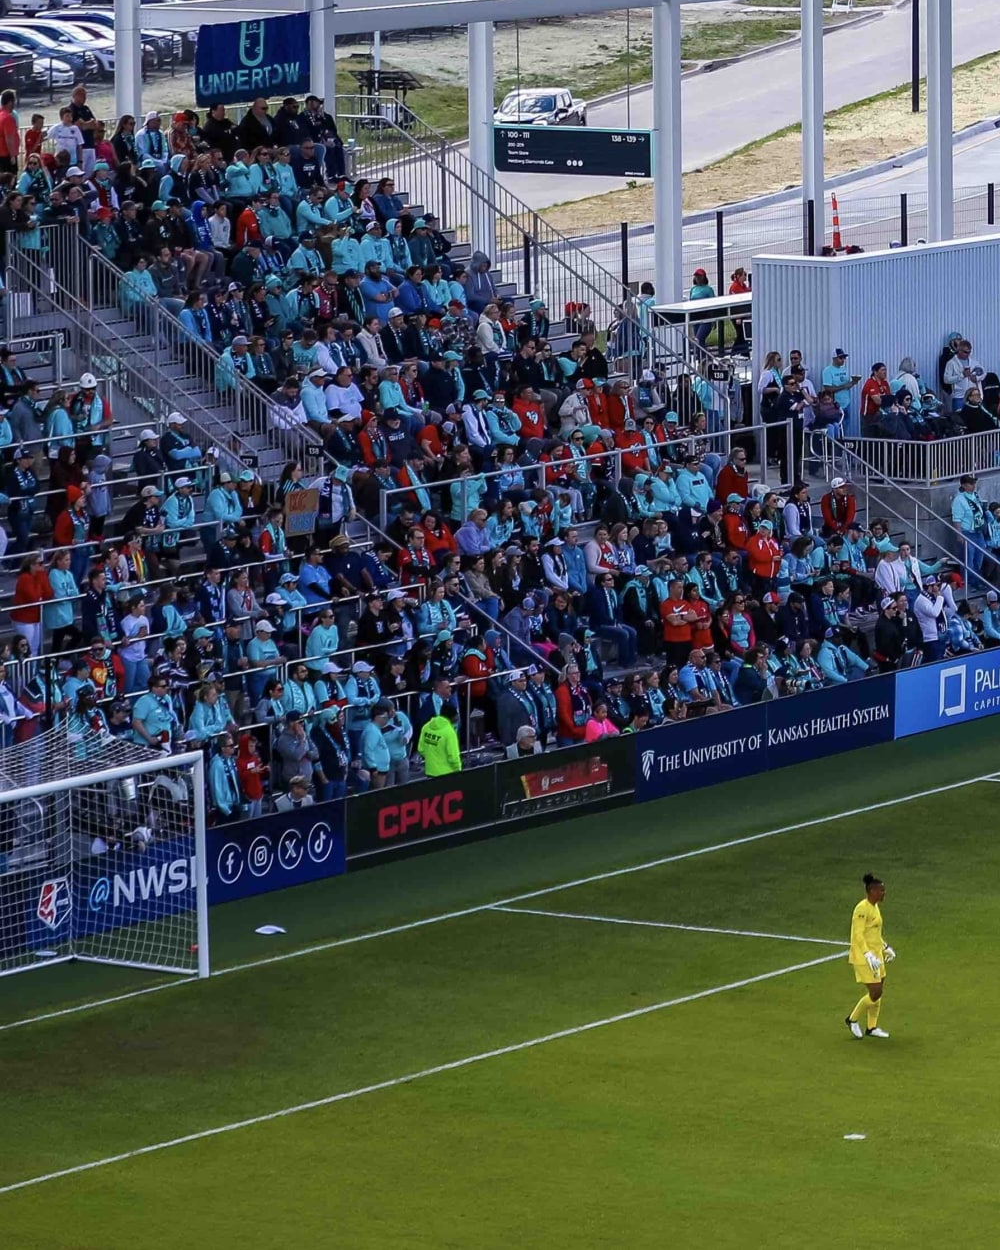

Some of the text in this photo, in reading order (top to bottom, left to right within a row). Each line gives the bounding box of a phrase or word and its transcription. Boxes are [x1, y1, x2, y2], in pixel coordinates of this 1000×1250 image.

[199, 61, 300, 96] UNDERTOW
[657, 704, 889, 773] THE UNIVERSITY OF KANSAS HEALTH SYSTEM
[377, 790, 464, 839] CPKC
